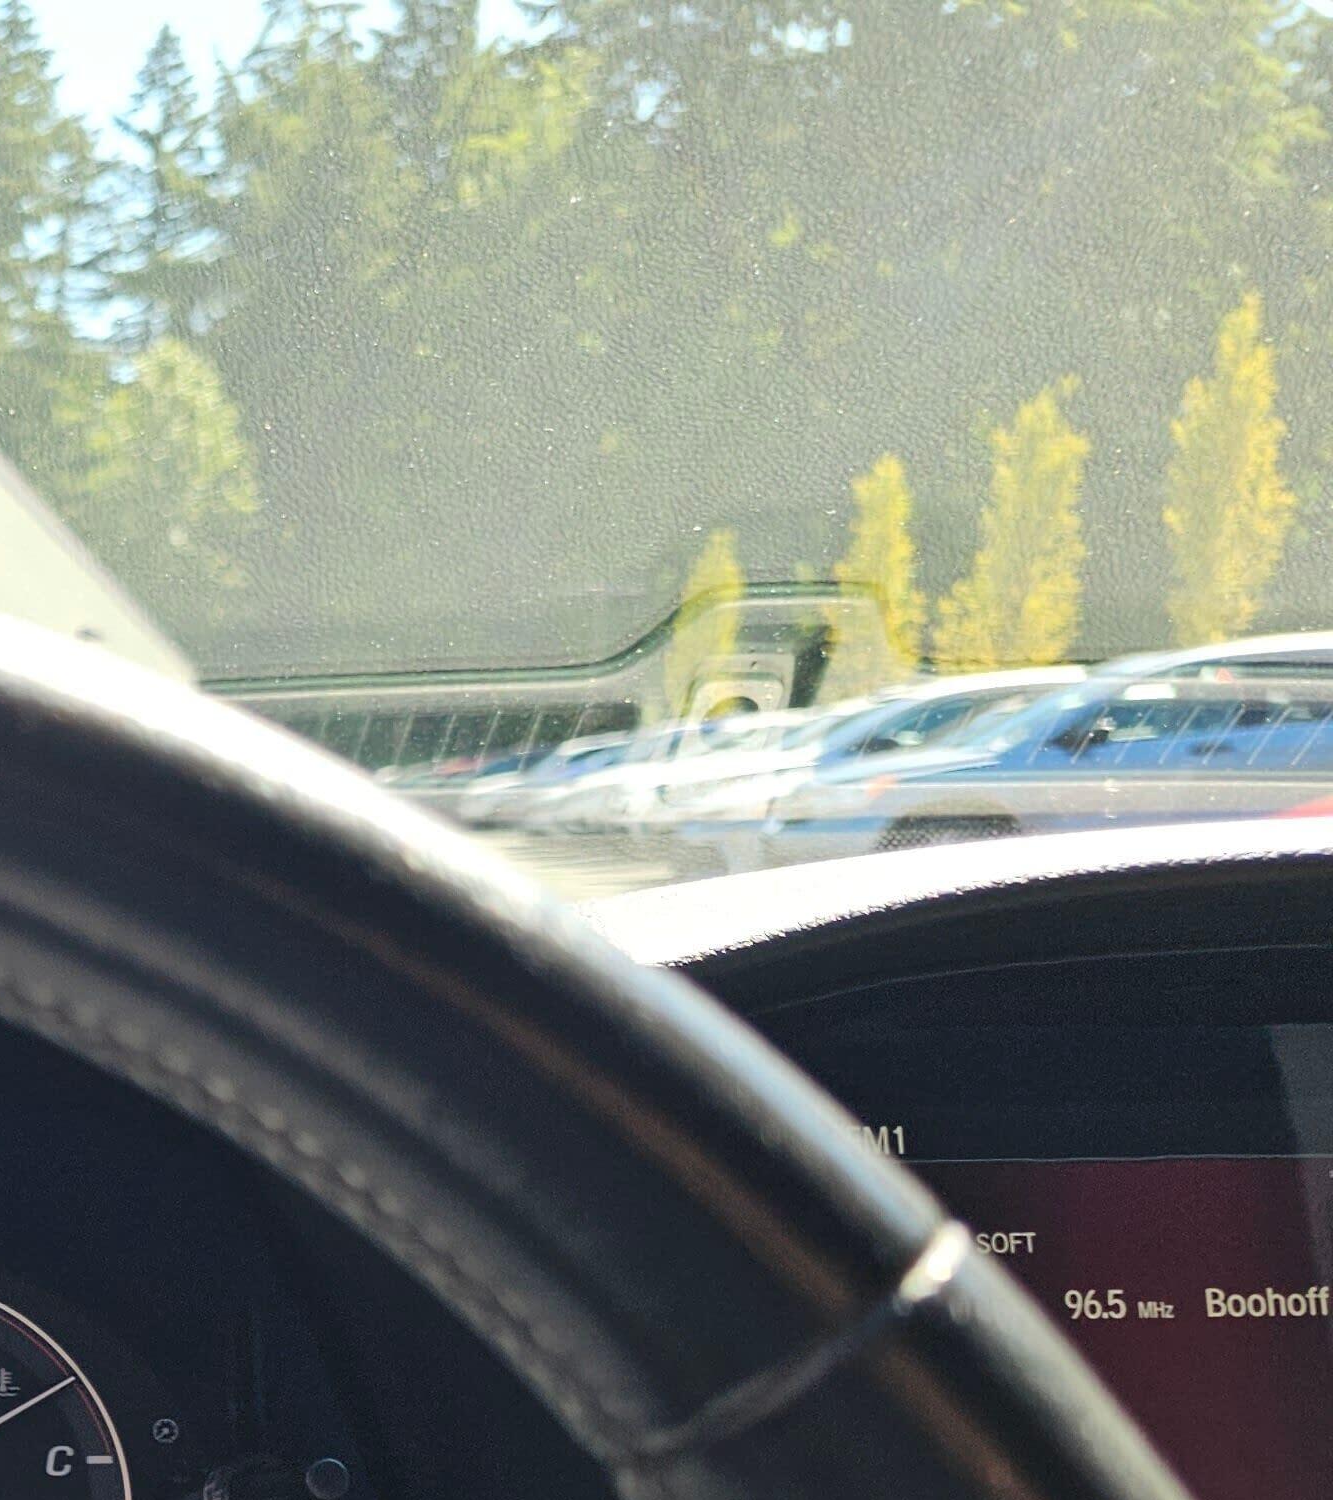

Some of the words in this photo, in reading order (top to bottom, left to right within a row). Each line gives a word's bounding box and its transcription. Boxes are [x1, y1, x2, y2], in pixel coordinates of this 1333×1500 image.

[851, 1126, 904, 1154] M1
[976, 1232, 1036, 1254] SOFT
[1065, 1289, 1126, 1319] 96.5
[1138, 1301, 1174, 1318] MHz
[1205, 1286, 1329, 1317] Boohoff
[46, 1446, 73, 1476] C
